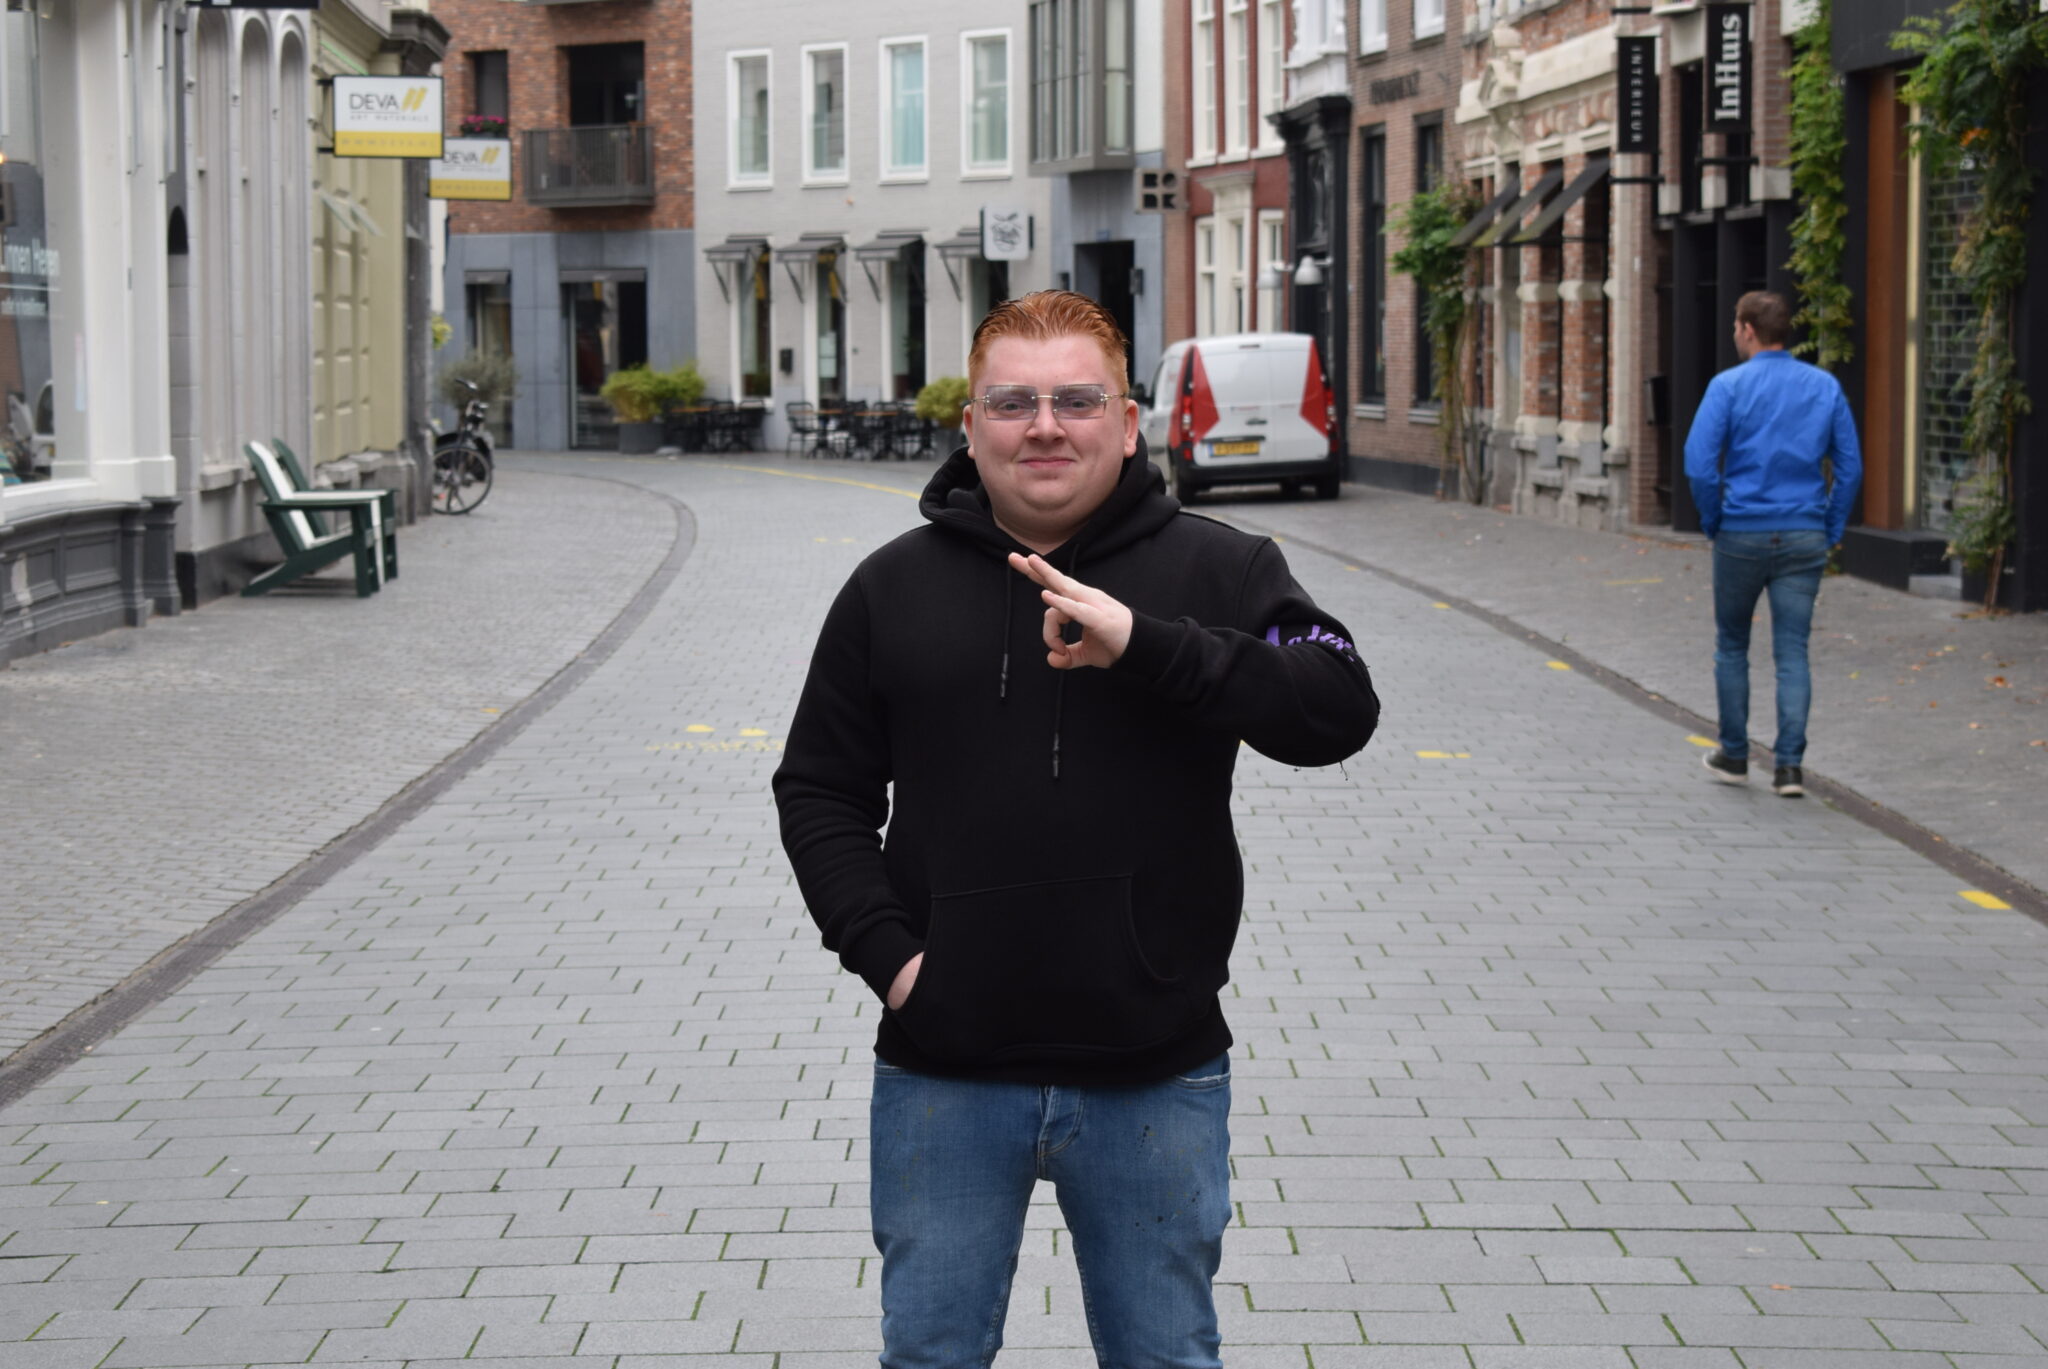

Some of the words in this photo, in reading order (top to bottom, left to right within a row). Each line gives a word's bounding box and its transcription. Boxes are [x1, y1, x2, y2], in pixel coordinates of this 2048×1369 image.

[350, 94, 399, 110] DEVA
[1631, 45, 1643, 143] INTERIEUR
[1714, 13, 1741, 121] InHuis
